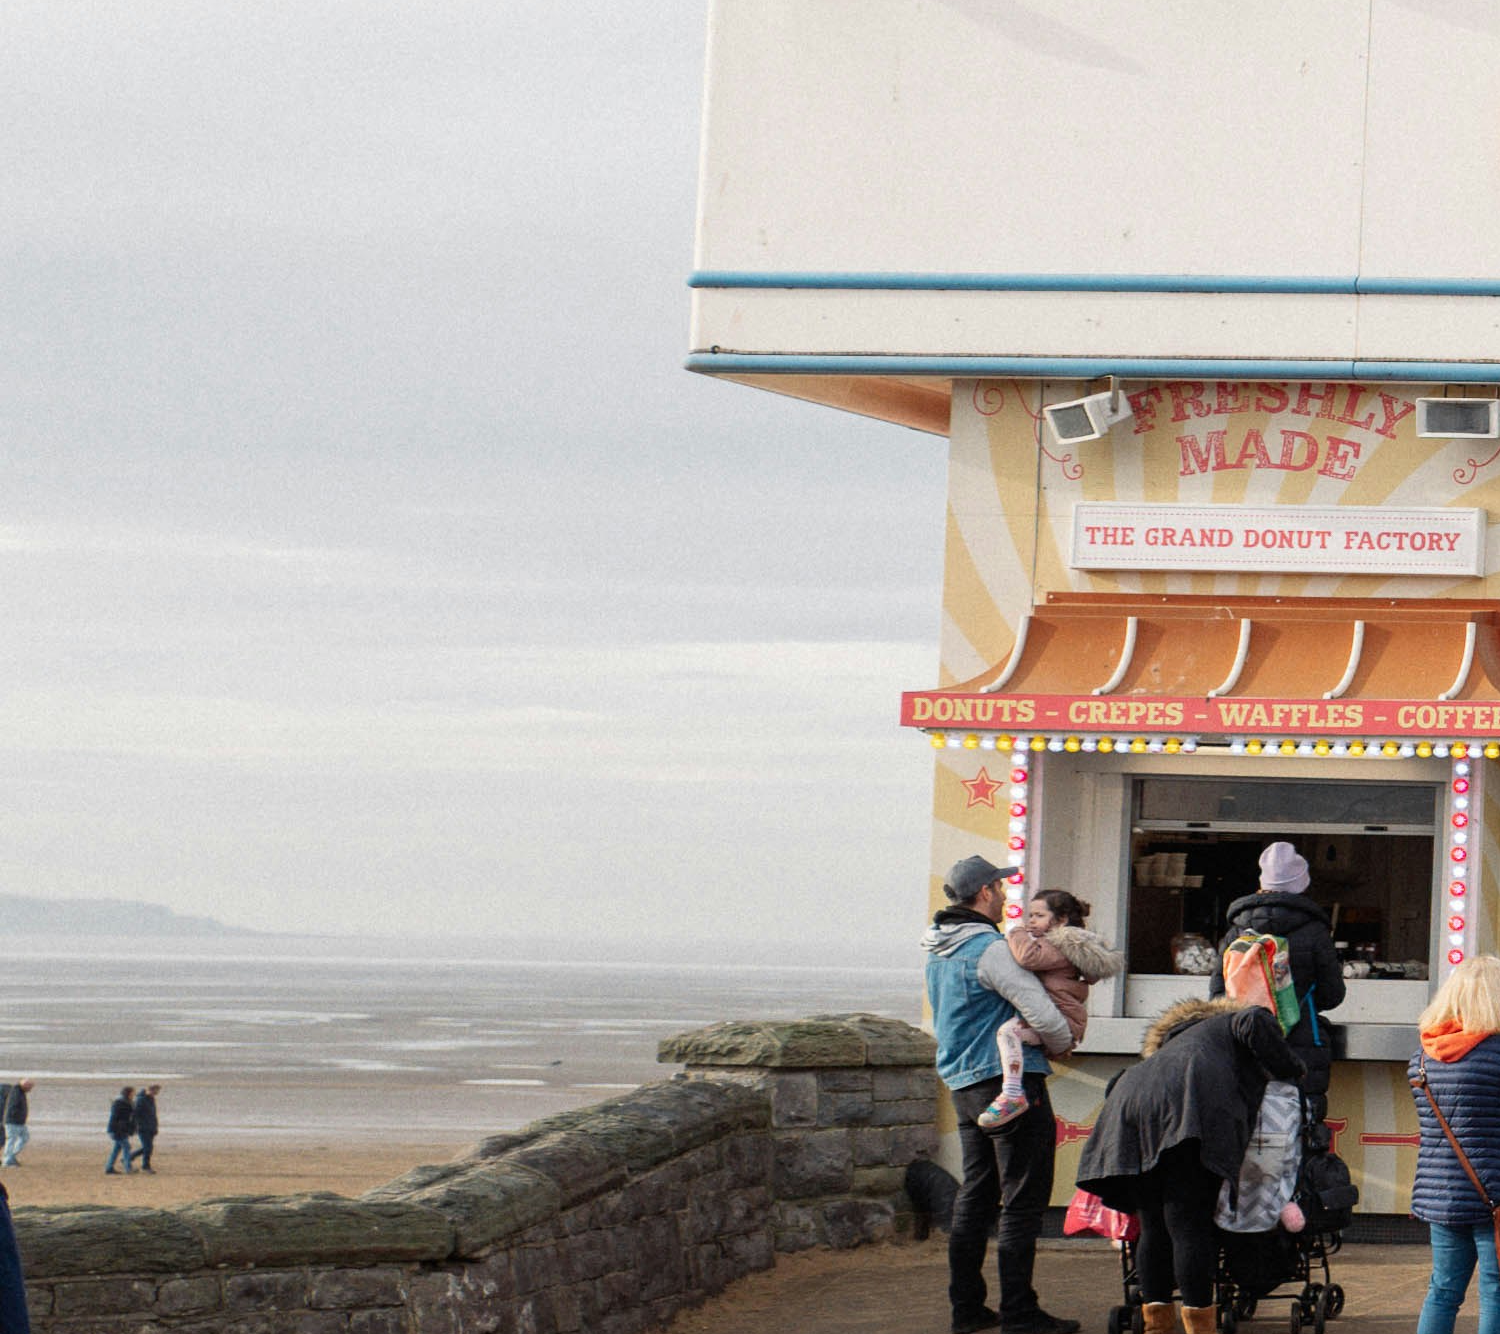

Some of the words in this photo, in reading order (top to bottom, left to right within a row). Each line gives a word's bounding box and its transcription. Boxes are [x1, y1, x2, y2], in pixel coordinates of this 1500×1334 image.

[1126, 382, 1416, 440] FRESHLY
[1176, 428, 1362, 481] MADE
[1085, 526, 1134, 546] THE
[1144, 527, 1233, 548] GRAND
[1242, 529, 1331, 550] DONUT
[1344, 531, 1461, 552] FACTORY
[912, 697, 1036, 723] DONUTS
[1068, 701, 1185, 726] CREPES
[1219, 703, 1364, 728] WAFFLES
